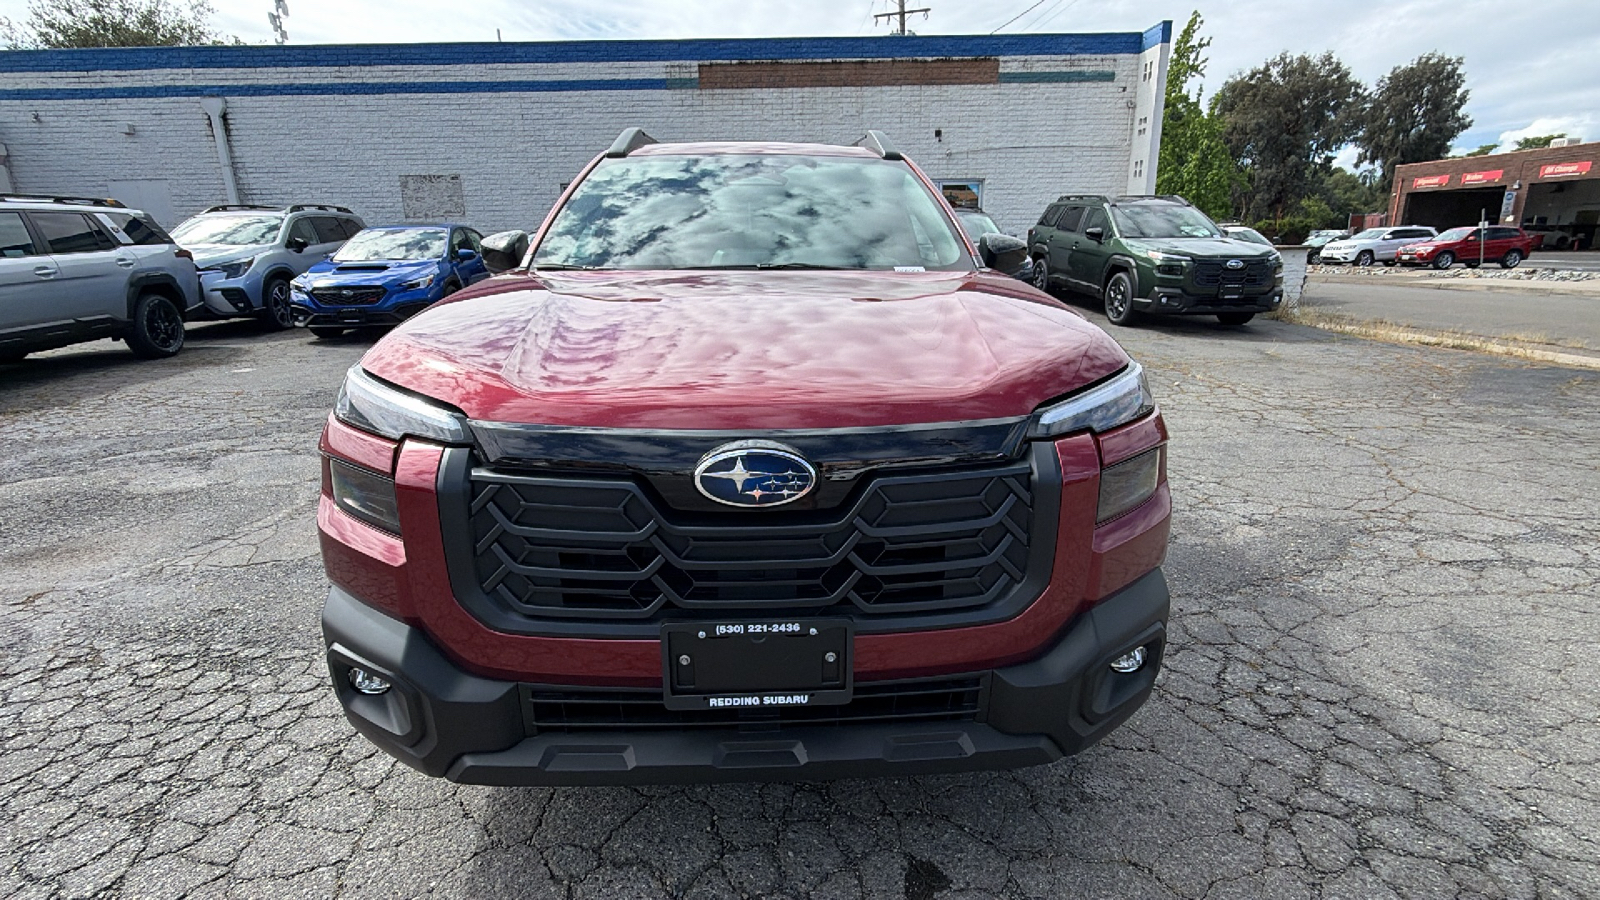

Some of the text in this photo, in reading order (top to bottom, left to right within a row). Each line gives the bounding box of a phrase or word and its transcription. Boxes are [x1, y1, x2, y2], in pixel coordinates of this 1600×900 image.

[716, 623, 800, 635] (530) 221-2436
[709, 695, 808, 707] REDDING SUBARU
